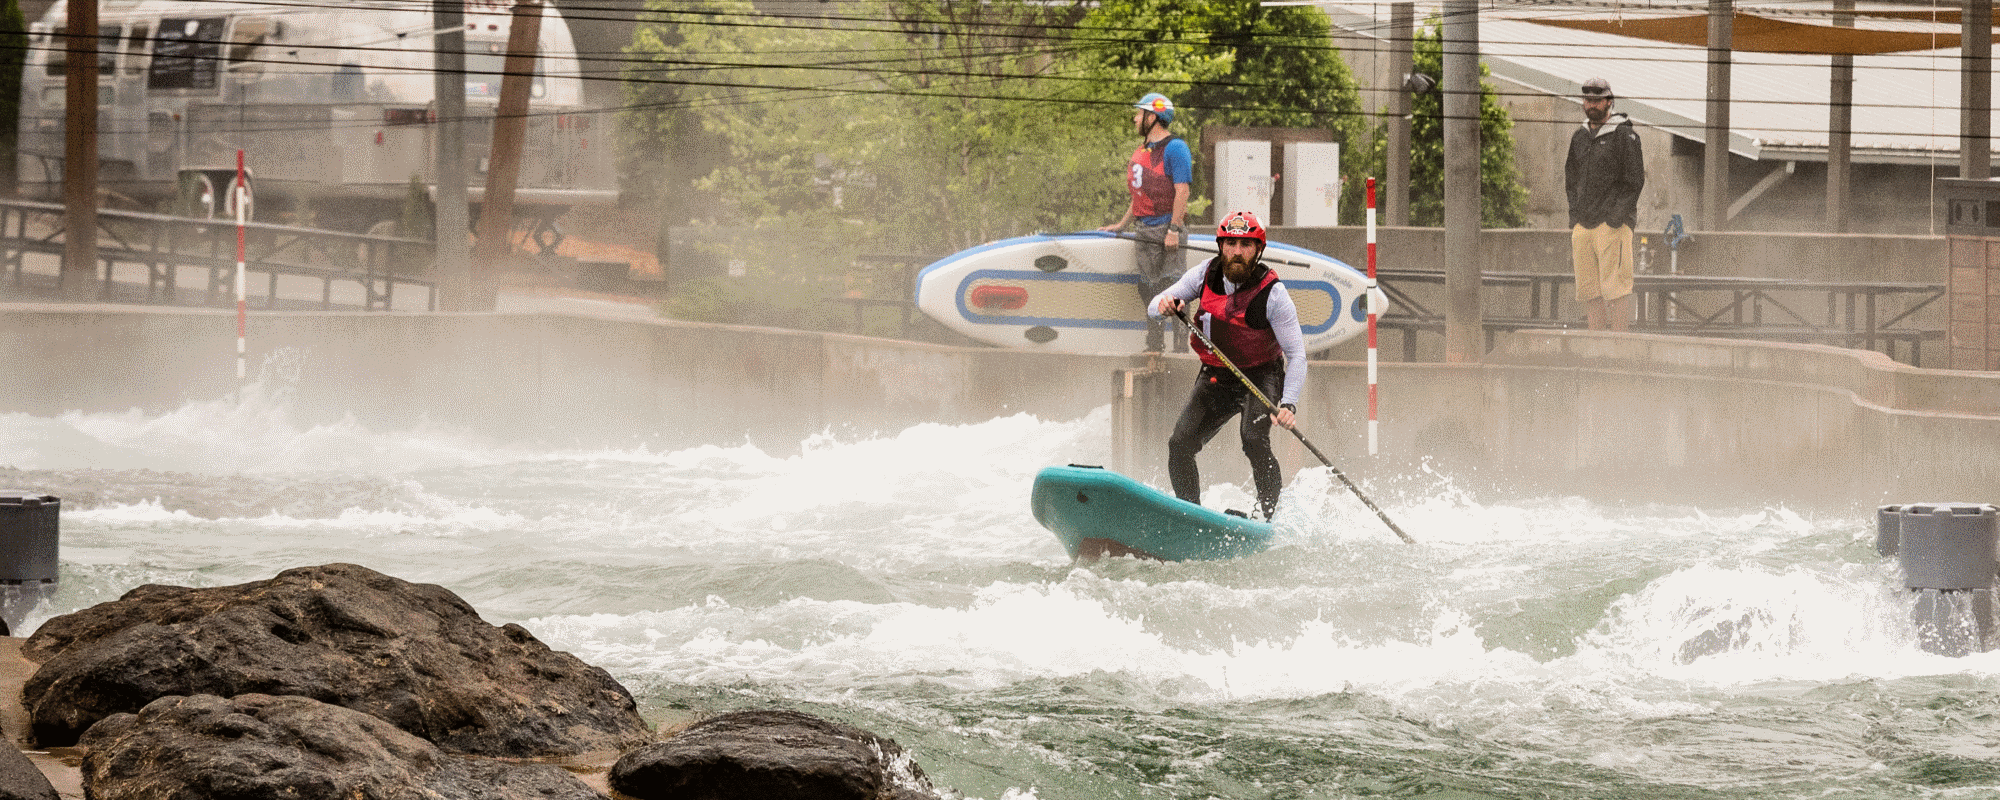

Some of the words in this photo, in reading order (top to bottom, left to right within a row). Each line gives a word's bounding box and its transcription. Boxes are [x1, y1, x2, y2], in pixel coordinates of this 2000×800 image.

[1131, 163, 1143, 189] 3
[1187, 322, 1212, 348] TOWER
[1199, 312, 1212, 341] 1
